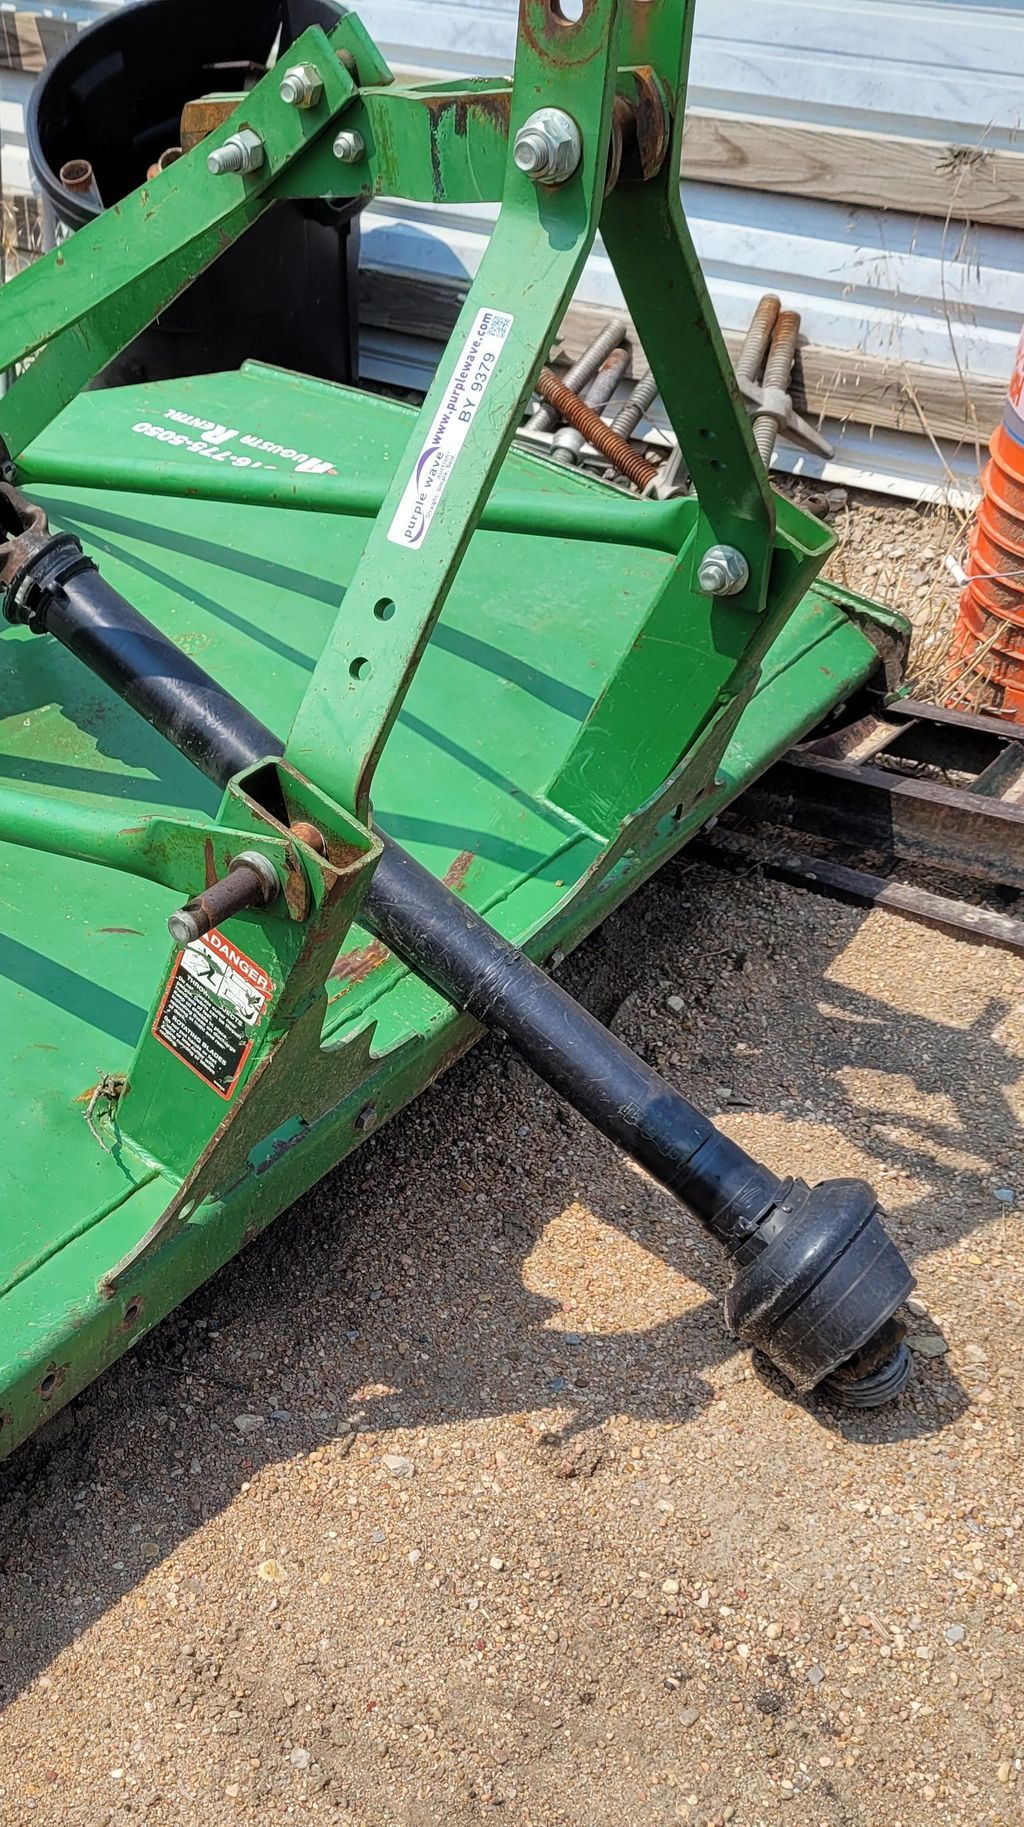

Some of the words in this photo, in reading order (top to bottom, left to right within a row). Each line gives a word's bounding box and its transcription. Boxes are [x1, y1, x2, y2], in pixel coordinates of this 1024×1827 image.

[432, 313, 493, 445] www.purplewave.com
[458, 401, 476, 423] BY
[471, 352, 496, 392] 9379
[404, 492, 427, 539] purple
[424, 452, 444, 487] wave
[208, 933, 268, 991] DANGER
